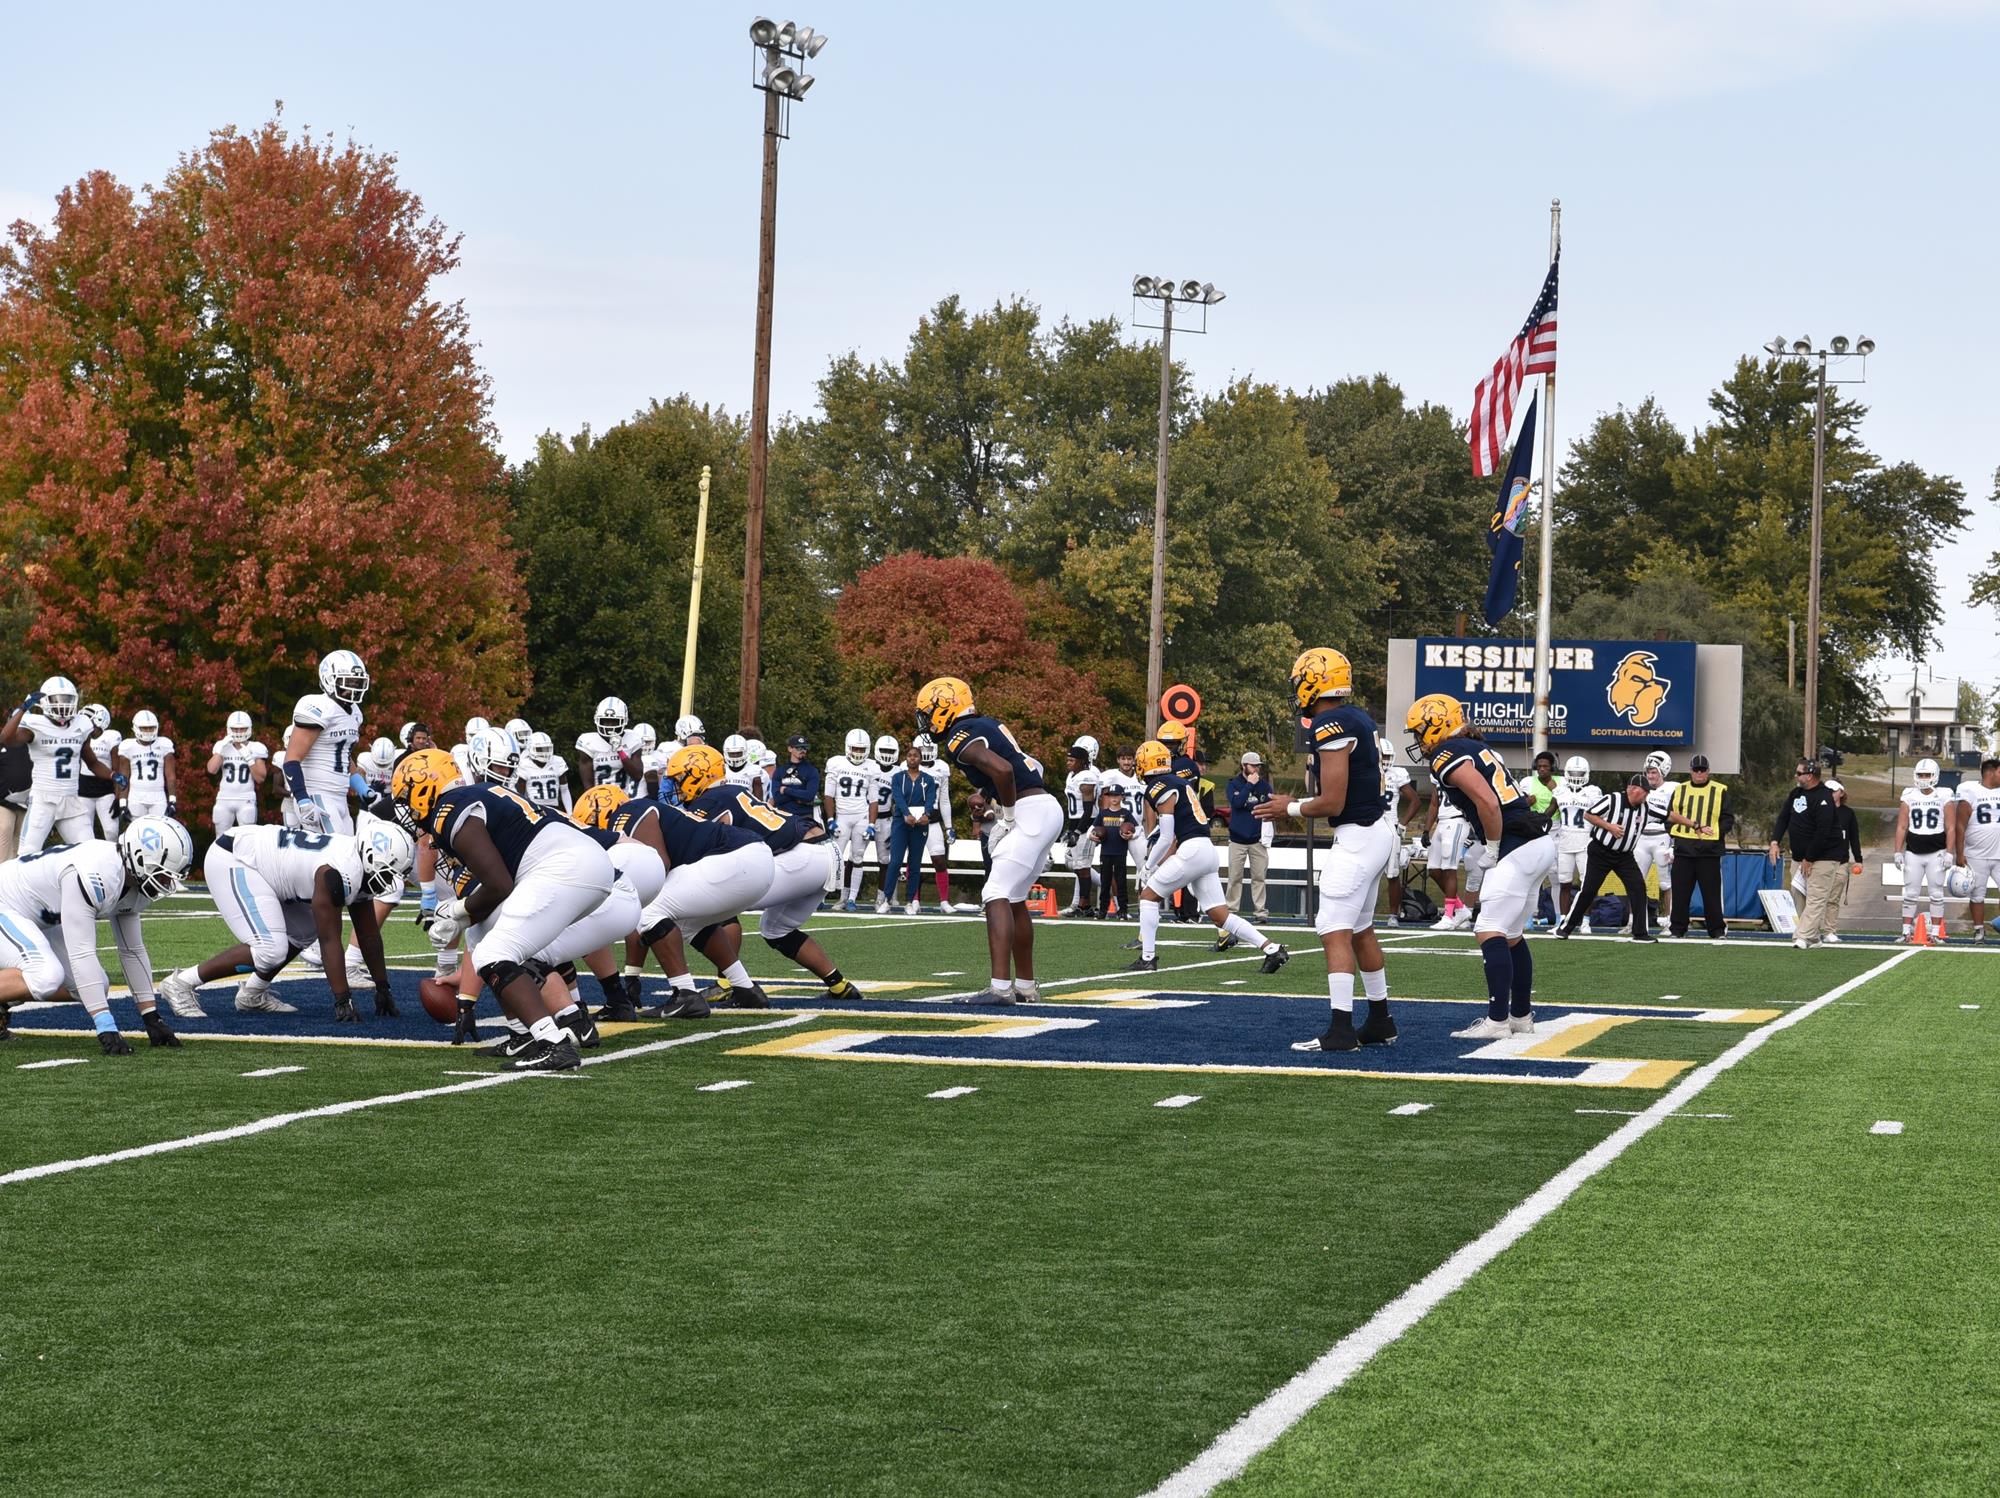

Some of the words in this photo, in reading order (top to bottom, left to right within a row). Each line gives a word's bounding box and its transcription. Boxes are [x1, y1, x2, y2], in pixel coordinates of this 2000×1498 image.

[1465, 670, 1552, 693] FIEL
[1473, 718, 1527, 727] COMMUNITY
[1527, 719, 1567, 728] CEGE
[1591, 728, 1684, 738] SCOTTIEATHLETICS.COM
[55, 747, 73, 779] 2
[135, 759, 158, 781] 13
[223, 763, 250, 784] 30
[531, 779, 557, 800] 36
[839, 776, 865, 797] 91
[1122, 791, 1145, 815] 58
[1561, 807, 1585, 829] 14
[1911, 808, 1940, 830] 86
